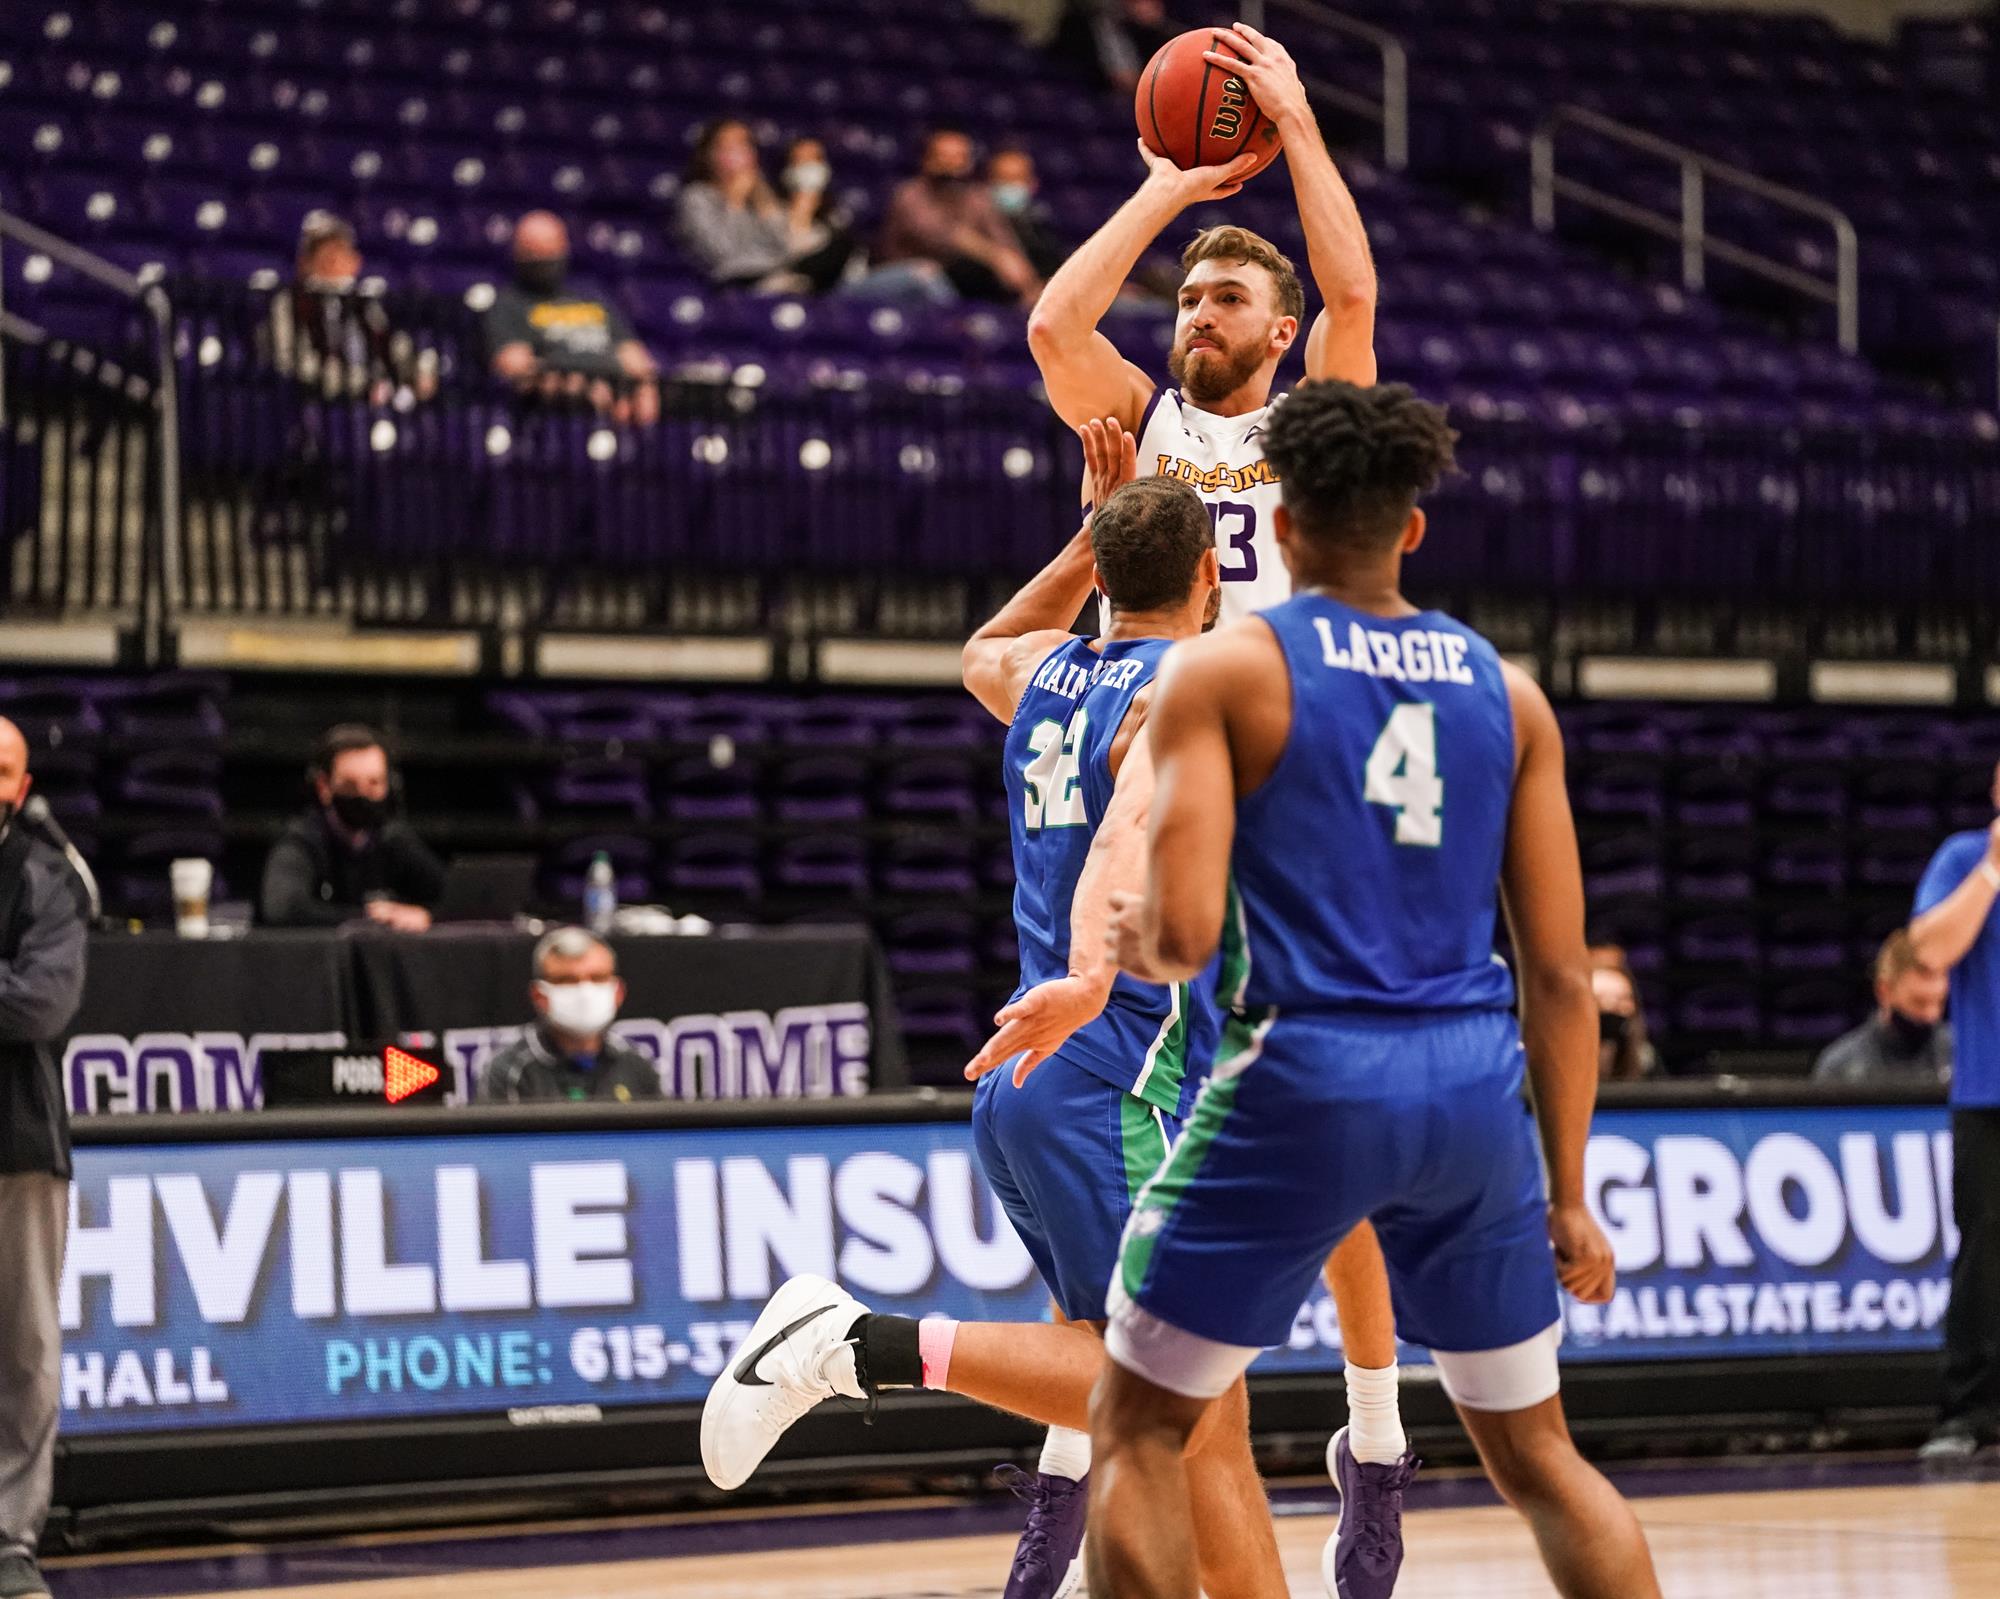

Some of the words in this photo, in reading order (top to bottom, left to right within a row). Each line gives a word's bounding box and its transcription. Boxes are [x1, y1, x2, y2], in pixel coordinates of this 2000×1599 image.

[1156, 454, 1282, 493] LIPSCOM
[1313, 617, 1474, 686] LARGIE
[1024, 707, 1090, 830] 32
[1364, 702, 1443, 847] 4
[674, 1149, 1035, 1301] INSU
[62, 1347, 229, 1410] HALL
[326, 1331, 553, 1394] PHONE:
